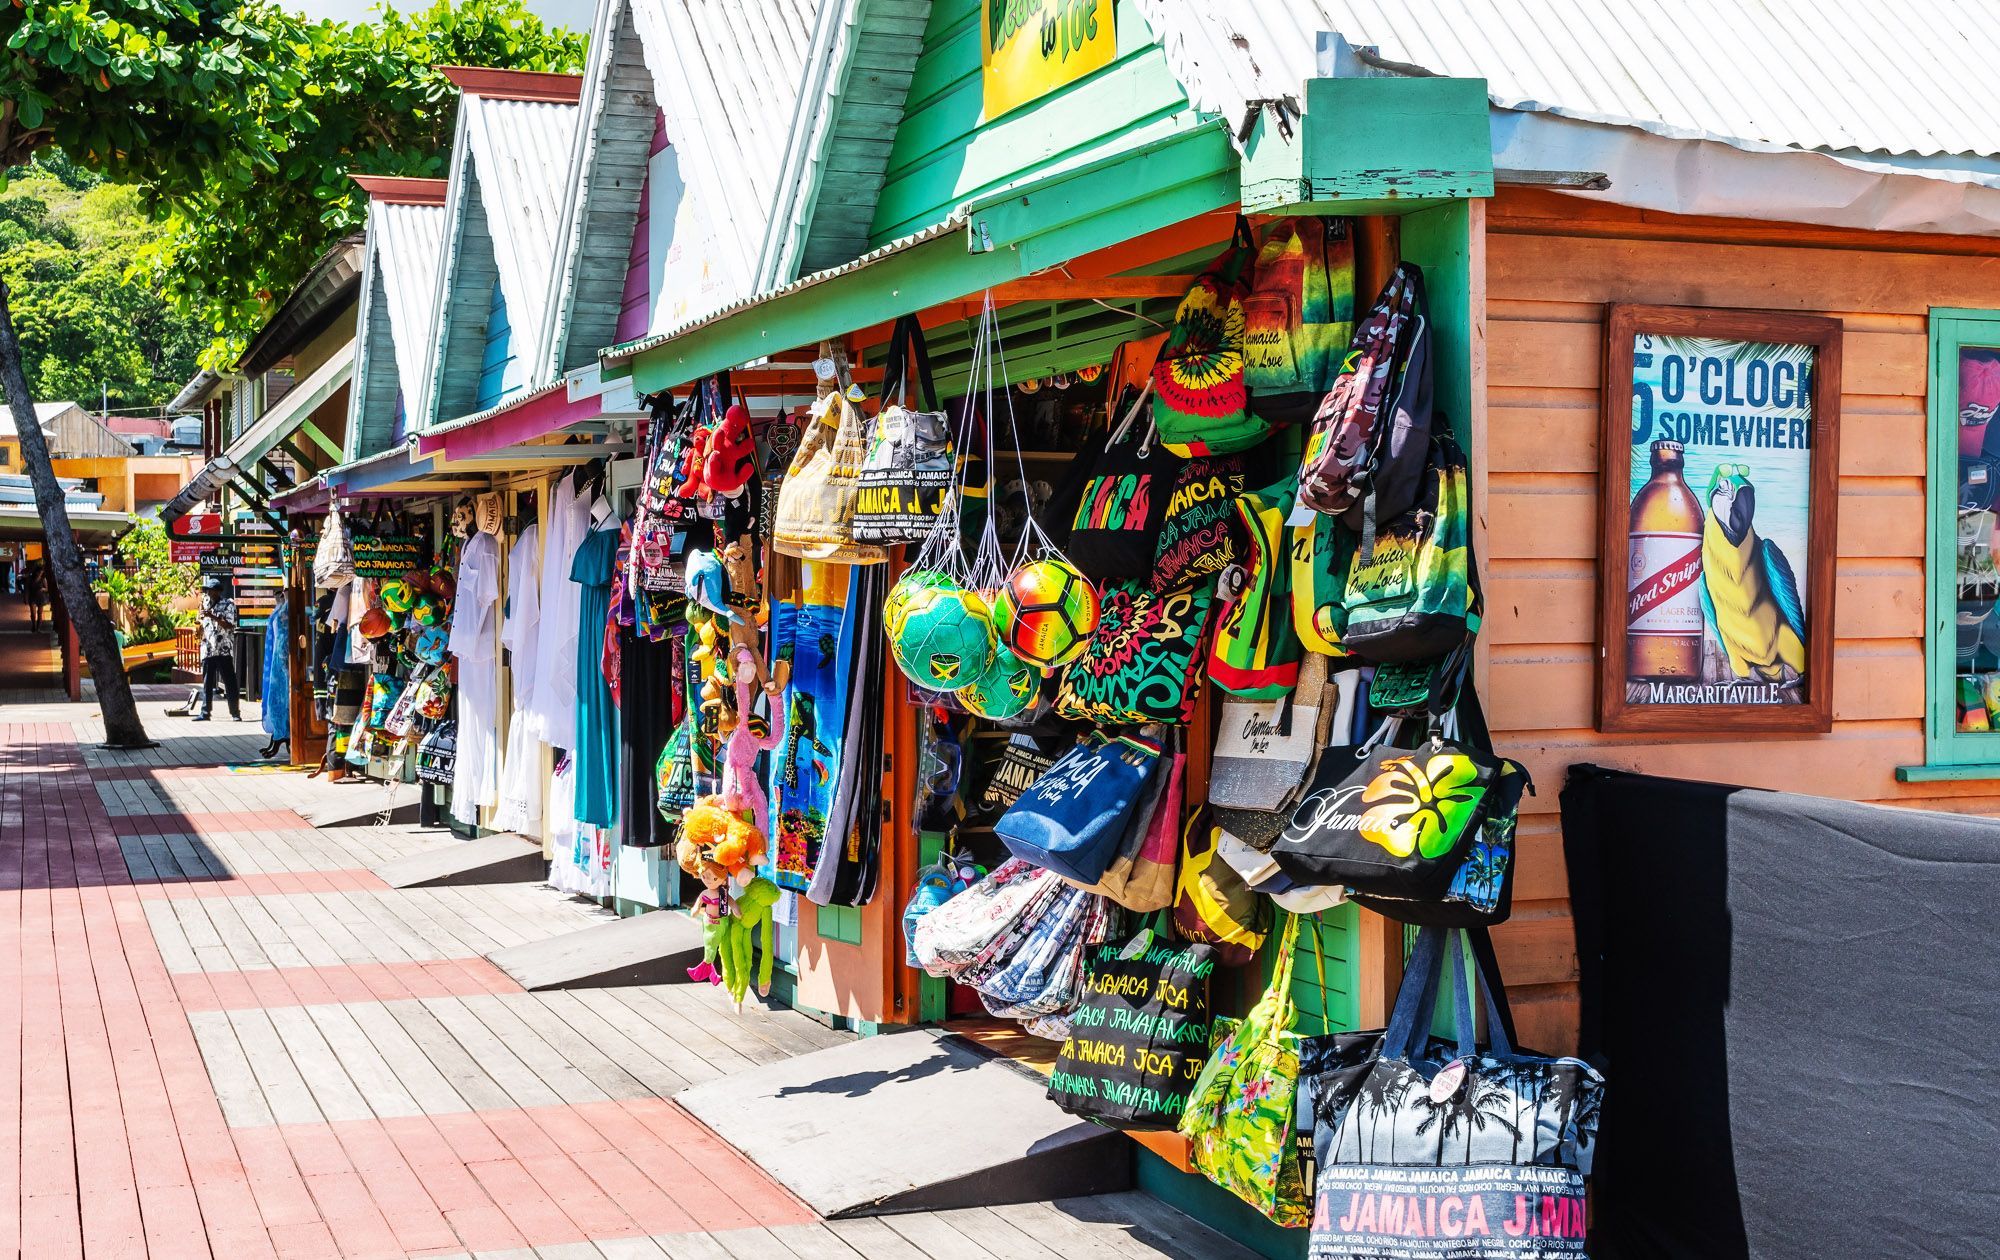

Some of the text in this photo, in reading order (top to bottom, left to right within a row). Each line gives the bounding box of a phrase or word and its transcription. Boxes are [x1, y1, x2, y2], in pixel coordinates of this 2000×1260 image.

[857, 487, 902, 514] JAMAICA
[1370, 567, 1405, 590] Love
[1630, 583, 1659, 615] Red
[1649, 682, 1781, 705] MARGARITAVILLE
[996, 759, 1044, 791] JAMA
[1408, 1171, 1459, 1183] JAMAICA
[1463, 1168, 1512, 1181] JAMAICA
[1419, 1183, 1457, 1194] FALMOUTH
[1495, 1182, 1522, 1193] NEGRIL
[1339, 1191, 1491, 1238] JAMAICA
[1400, 1239, 1430, 1249] FALMOUTH
[1433, 1239, 1467, 1249] MONTEGO
[1467, 1238, 1479, 1248] BAY
[1482, 1238, 1506, 1248] NEGRIL
[1508, 1239, 1532, 1249] OCHO
